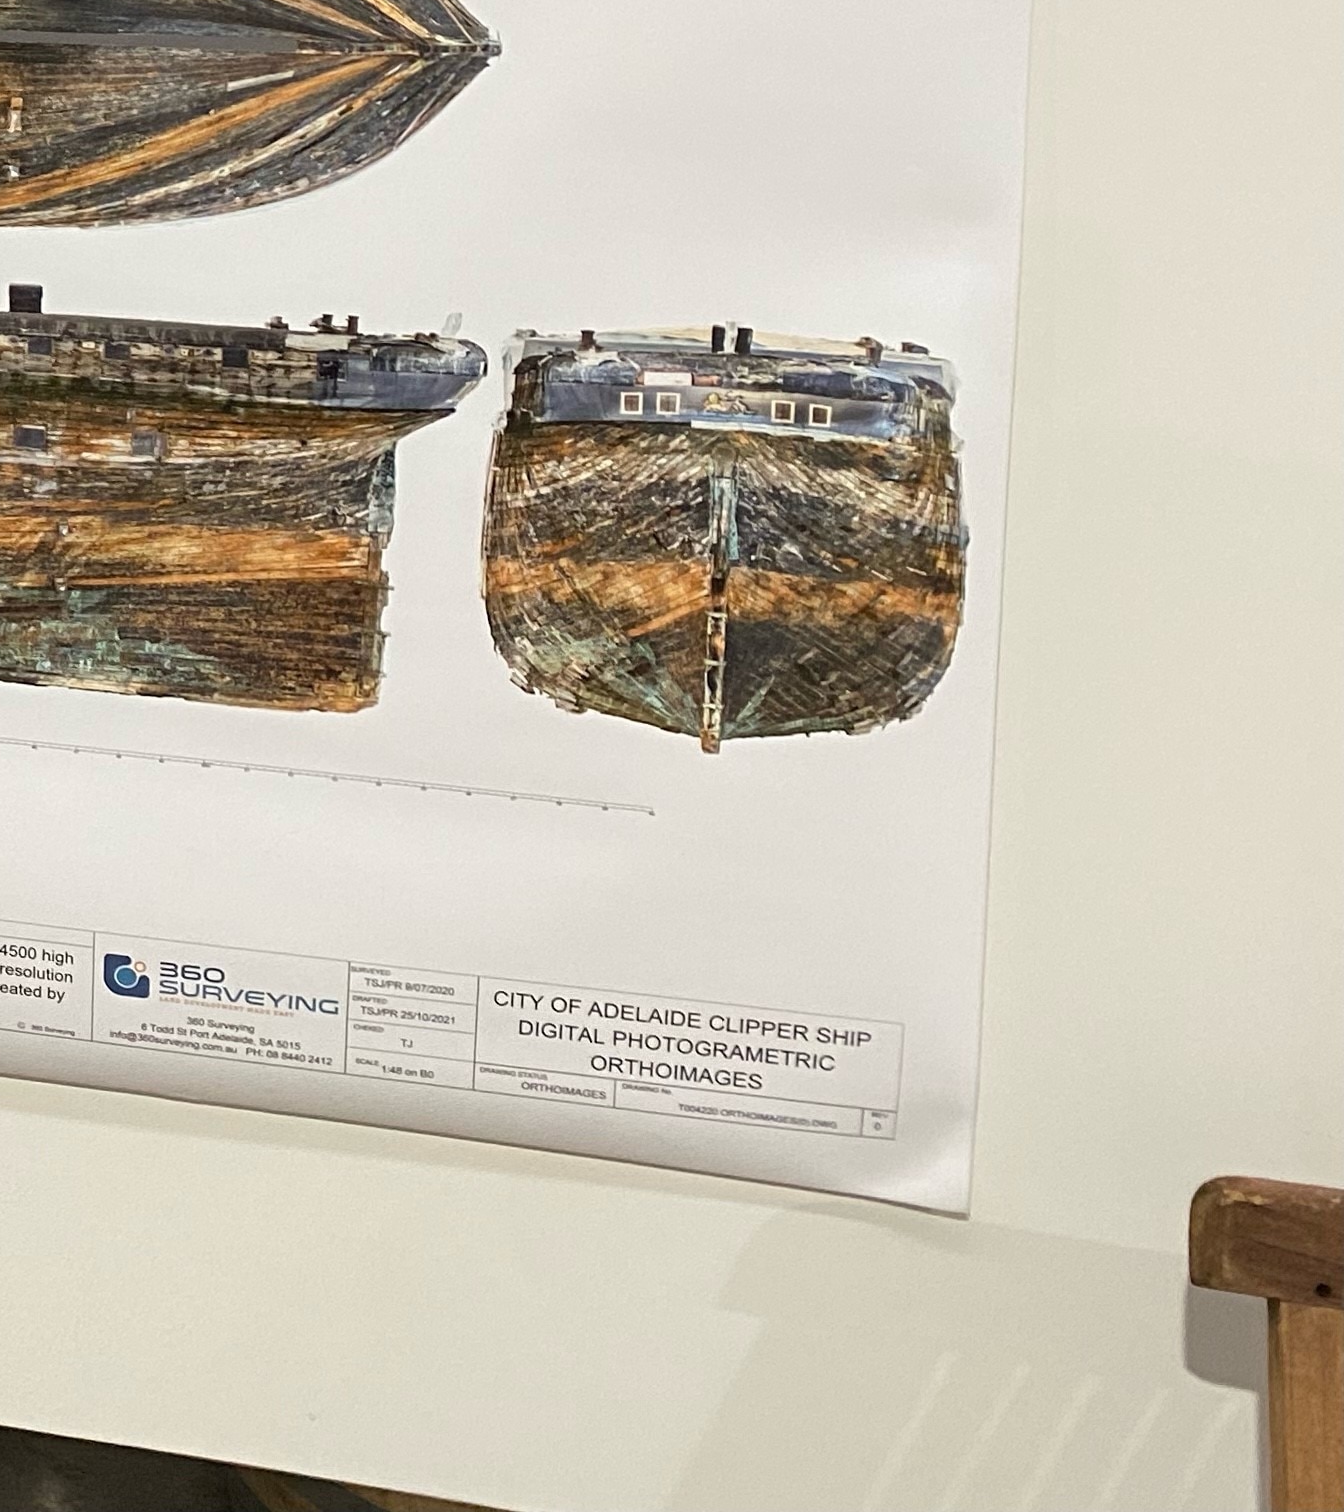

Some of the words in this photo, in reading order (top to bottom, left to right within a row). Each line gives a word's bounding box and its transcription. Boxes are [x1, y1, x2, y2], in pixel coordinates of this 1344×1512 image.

[41, 948, 74, 967] high
[0, 964, 73, 984] resolution
[160, 961, 224, 984] 360
[47, 986, 66, 1004] by
[159, 978, 338, 1015] SURVEYING
[186, 1016, 204, 1026] 360
[207, 1019, 254, 1034] Surveying
[400, 1010, 455, 1024] 25/10/2021
[493, 990, 544, 1011] CITY
[551, 996, 581, 1015] OF
[587, 1001, 701, 1029] ADELAIDE
[708, 1014, 808, 1041] CLIPPER
[816, 1026, 871, 1048] SHIP
[150, 1023, 173, 1034] Todd
[177, 1027, 187, 1036] St
[190, 1029, 208, 1039] Port
[259, 1037, 273, 1046] SA
[276, 1039, 300, 1050] 5015
[401, 1038, 413, 1048] TJ
[518, 1019, 605, 1045] DIGITAL
[613, 1031, 836, 1071] PHOTOGRAMETRIC
[308, 1055, 332, 1066] 2412
[590, 1054, 763, 1090] ORTHOIMAGES
[521, 1081, 606, 1099] ORTHOIMAGES
